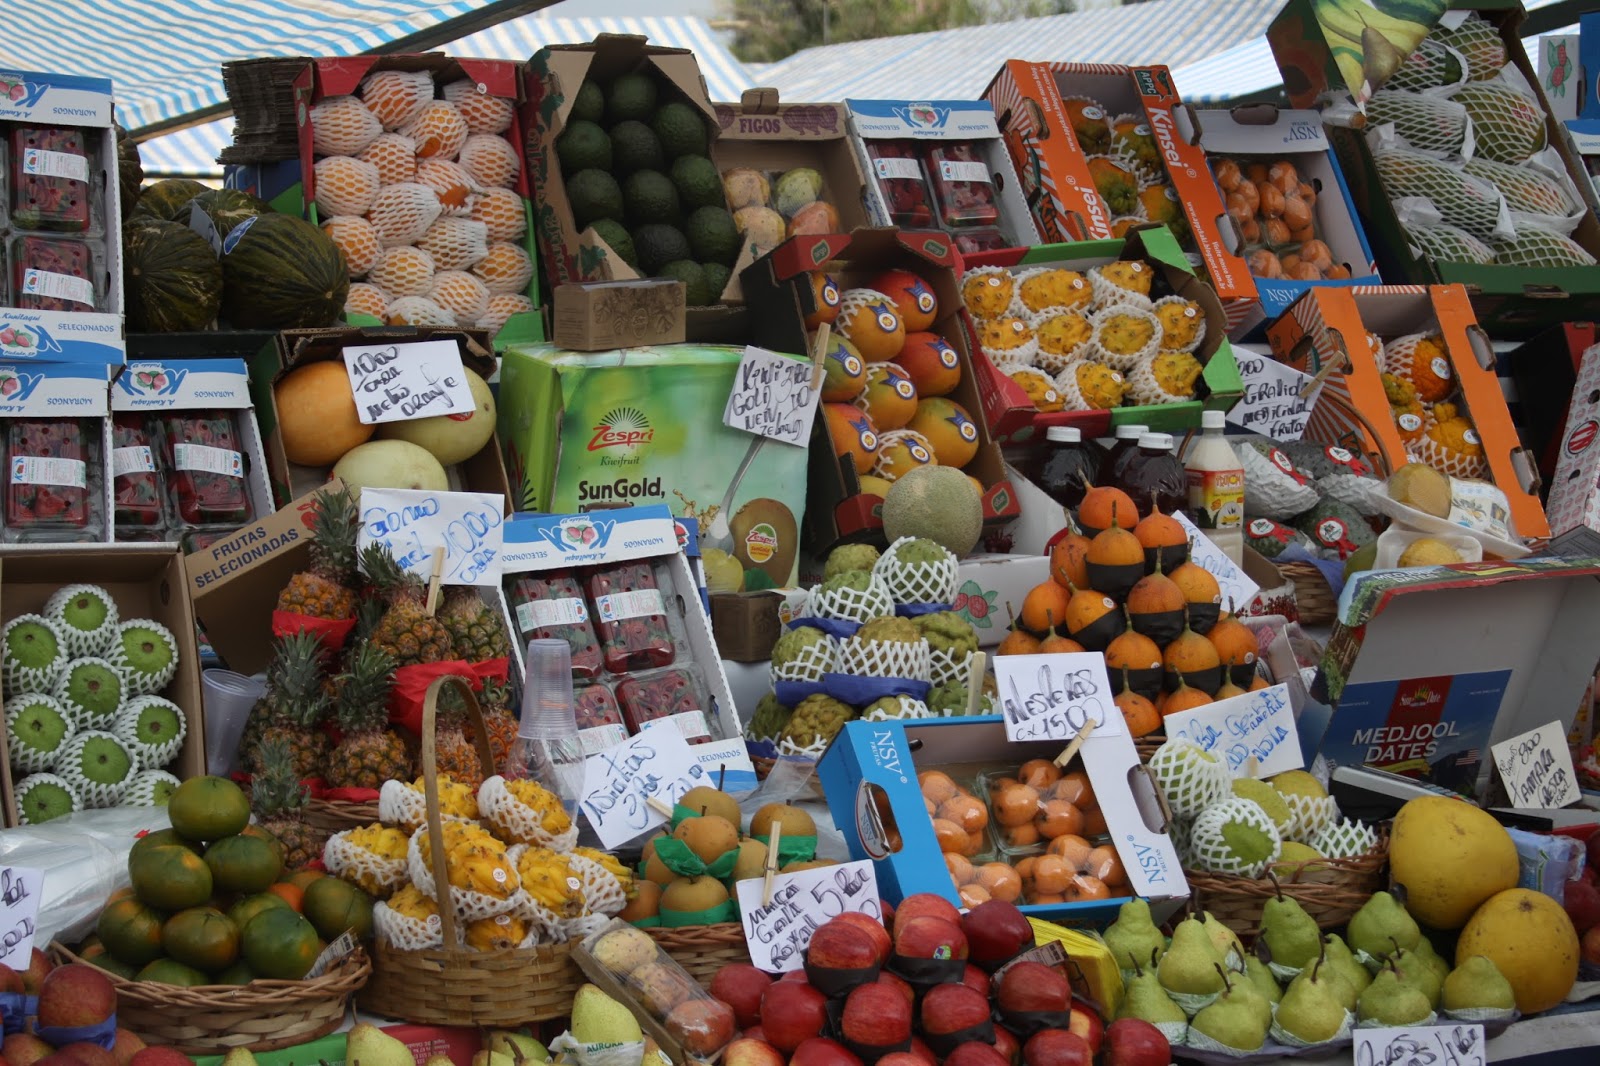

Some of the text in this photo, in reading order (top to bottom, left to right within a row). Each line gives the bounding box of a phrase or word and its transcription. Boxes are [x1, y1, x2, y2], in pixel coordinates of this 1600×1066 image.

[1141, 71, 1157, 95] APPC
[52, 106, 97, 117] MORANGOS
[739, 117, 781, 134] FIGOS
[1147, 107, 1189, 168] Kinsei
[58, 323, 115, 333] SELECIONADOS
[47, 397, 93, 405] MORANGOS
[194, 390, 235, 398] MORANGOS
[586, 425, 655, 452] Zespri
[600, 453, 640, 468] Kiwifruit
[578, 477, 666, 500] SunGold,
[211, 526, 267, 561] FRUTAS
[623, 537, 664, 549] MORANGOS
[194, 528, 300, 589] SELECIONADAS
[501, 550, 548, 562] SELECIONADO
[1351, 720, 1461, 746] MEDJOOL
[697, 749, 741, 763] LECIONADOS
[873, 730, 903, 775] NSV
[1364, 740, 1440, 764] DATES
[1132, 842, 1166, 884] NSV
